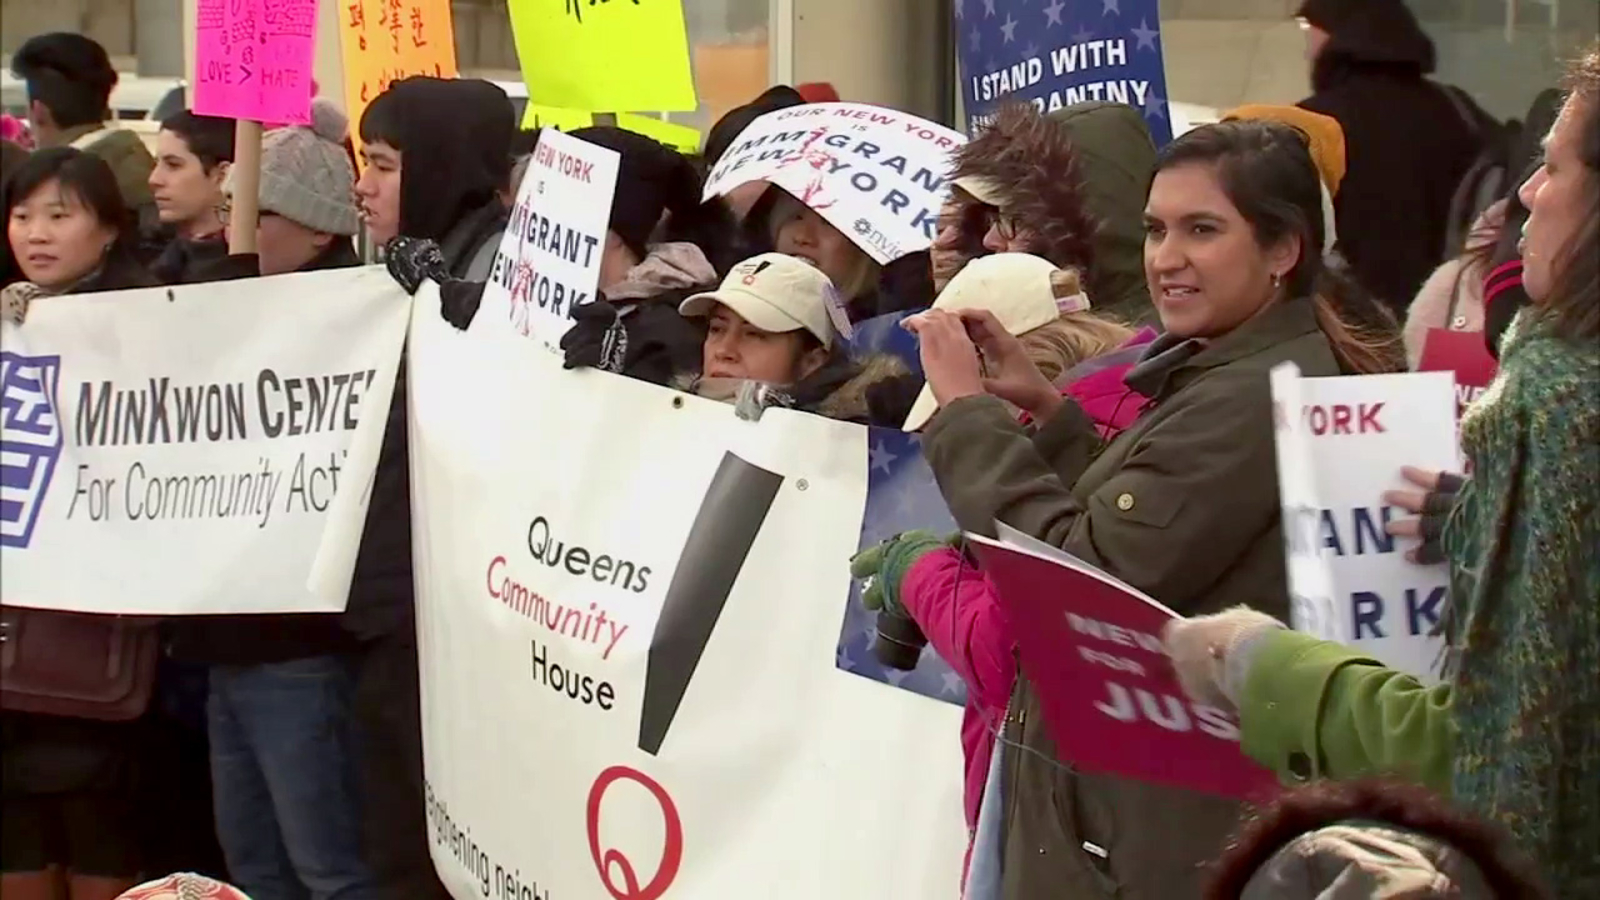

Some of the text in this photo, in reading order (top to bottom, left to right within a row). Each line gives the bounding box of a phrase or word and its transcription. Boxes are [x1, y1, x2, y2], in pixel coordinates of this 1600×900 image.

[200, 60, 232, 84] LOVE
[260, 67, 298, 88] HATE
[973, 39, 1127, 102] I STAND WITH
[777, 108, 825, 121] OUR
[833, 108, 896, 126] NEW
[558, 150, 595, 184] YORK
[722, 126, 946, 194] IMMIGRAN
[828, 156, 937, 240] YORK
[1301, 401, 1387, 437] ORK
[66, 448, 348, 530] For Community Act
[528, 515, 652, 593] Queens
[486, 555, 629, 660] Community
[531, 639, 615, 711] House
